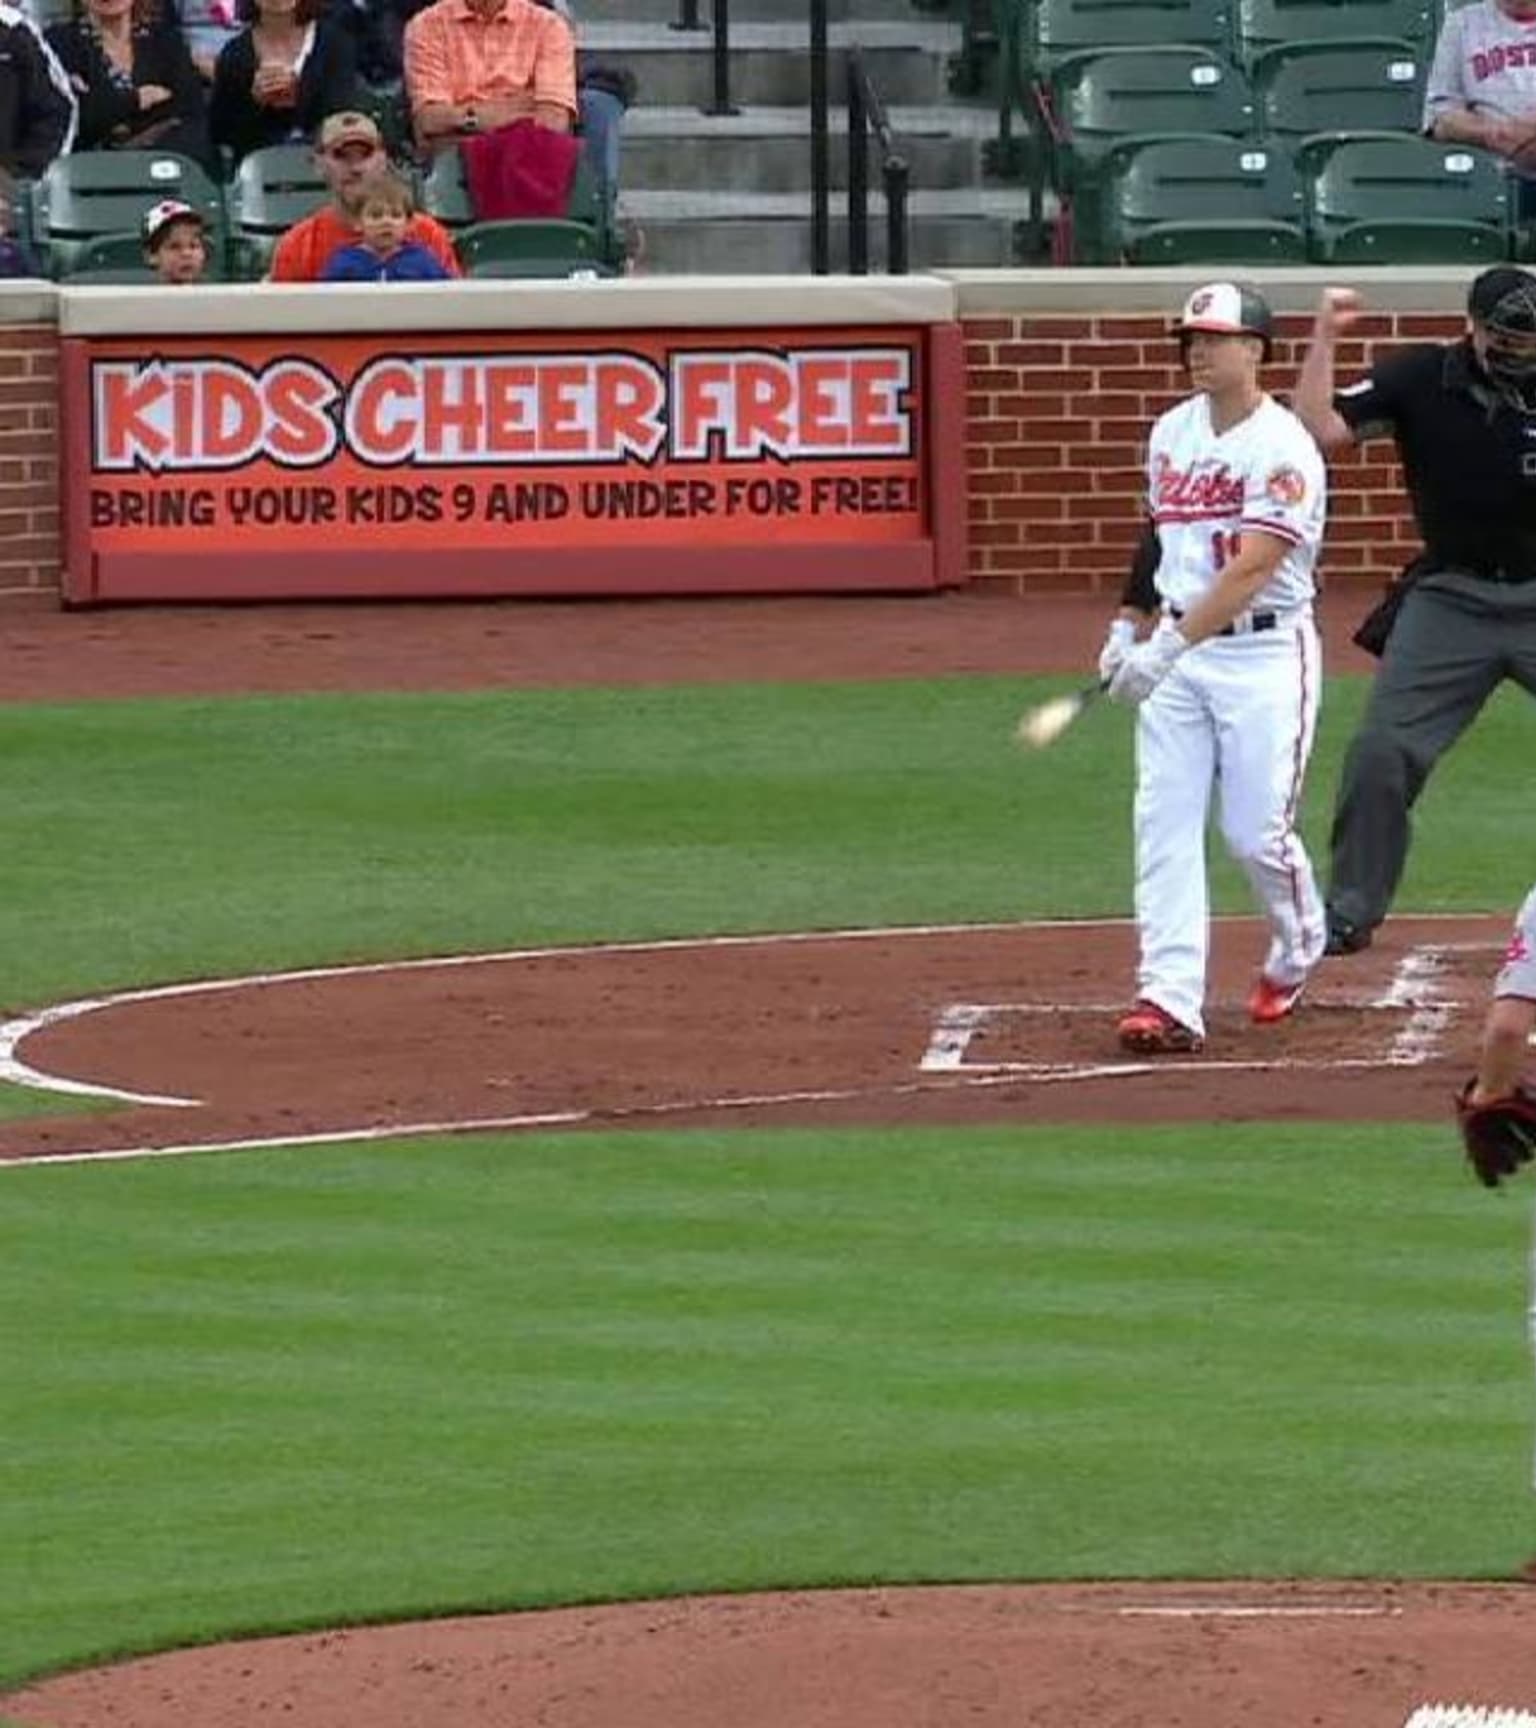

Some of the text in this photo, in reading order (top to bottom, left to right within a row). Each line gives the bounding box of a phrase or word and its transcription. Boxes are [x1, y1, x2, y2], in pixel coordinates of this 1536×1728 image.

[347, 354, 667, 465] CHEER
[670, 350, 911, 460] FREE
[91, 477, 918, 527] BRING YOUR KIDS 9 AND UNDER FOR FREE!
